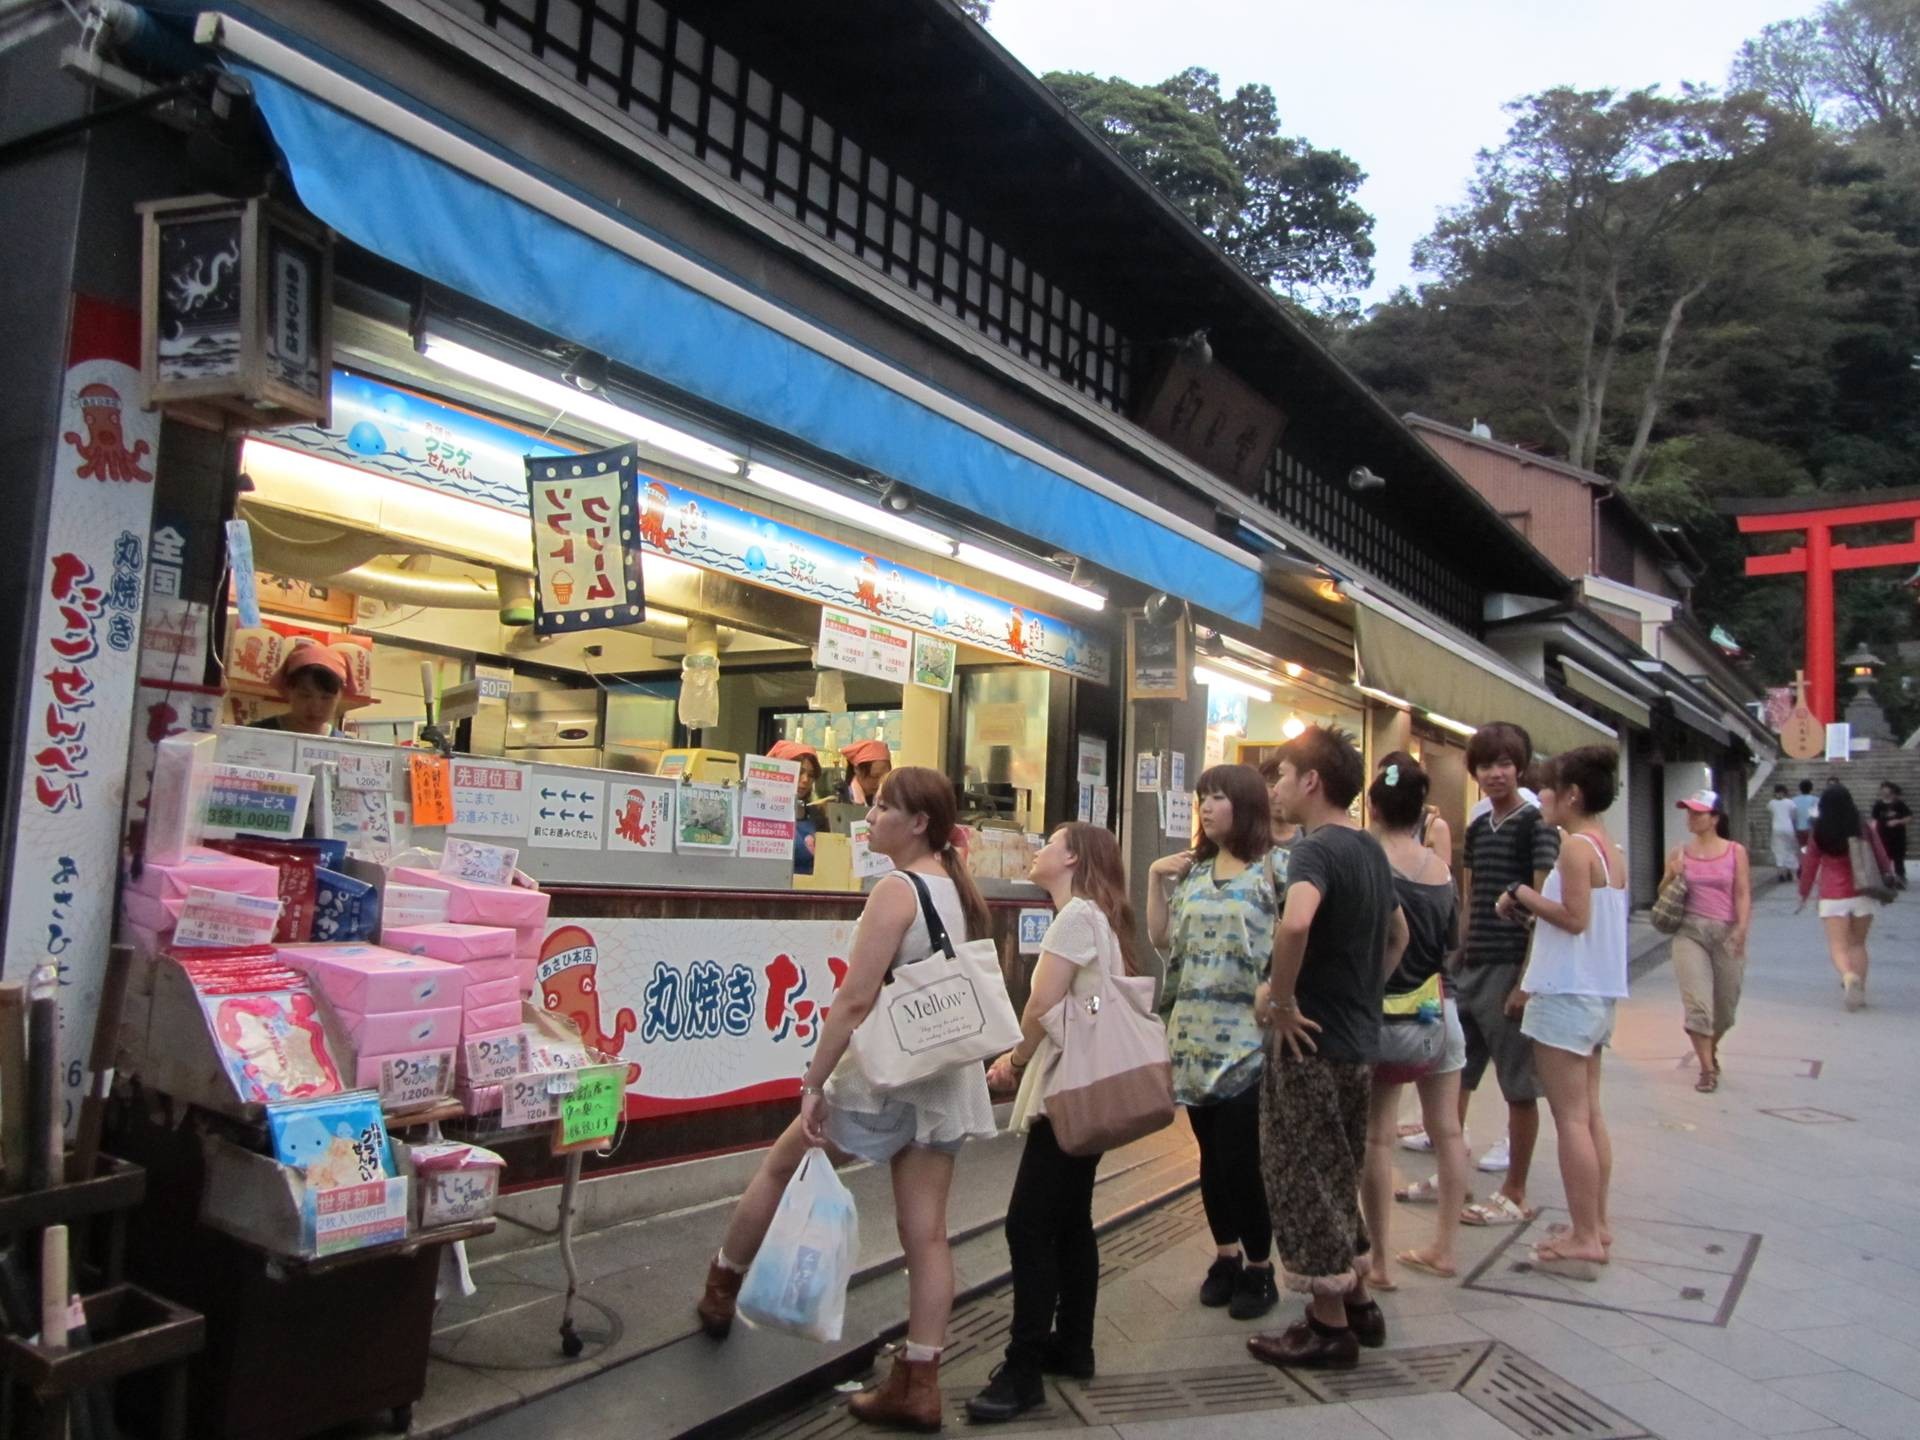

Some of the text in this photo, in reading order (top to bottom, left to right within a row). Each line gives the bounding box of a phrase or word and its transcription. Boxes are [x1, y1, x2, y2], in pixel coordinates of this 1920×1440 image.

[425, 437, 472, 466] クラゲ
[427, 452, 473, 480] せんべい
[107, 530, 142, 651] 丸焼き
[480, 680, 510, 698] 50円
[457, 766, 519, 789] 先頭位置
[456, 792, 496, 806] ここまで
[542, 949, 593, 978] あさひ本店
[642, 959, 756, 1043] 丸焼き
[903, 992, 966, 1023] Mellow
